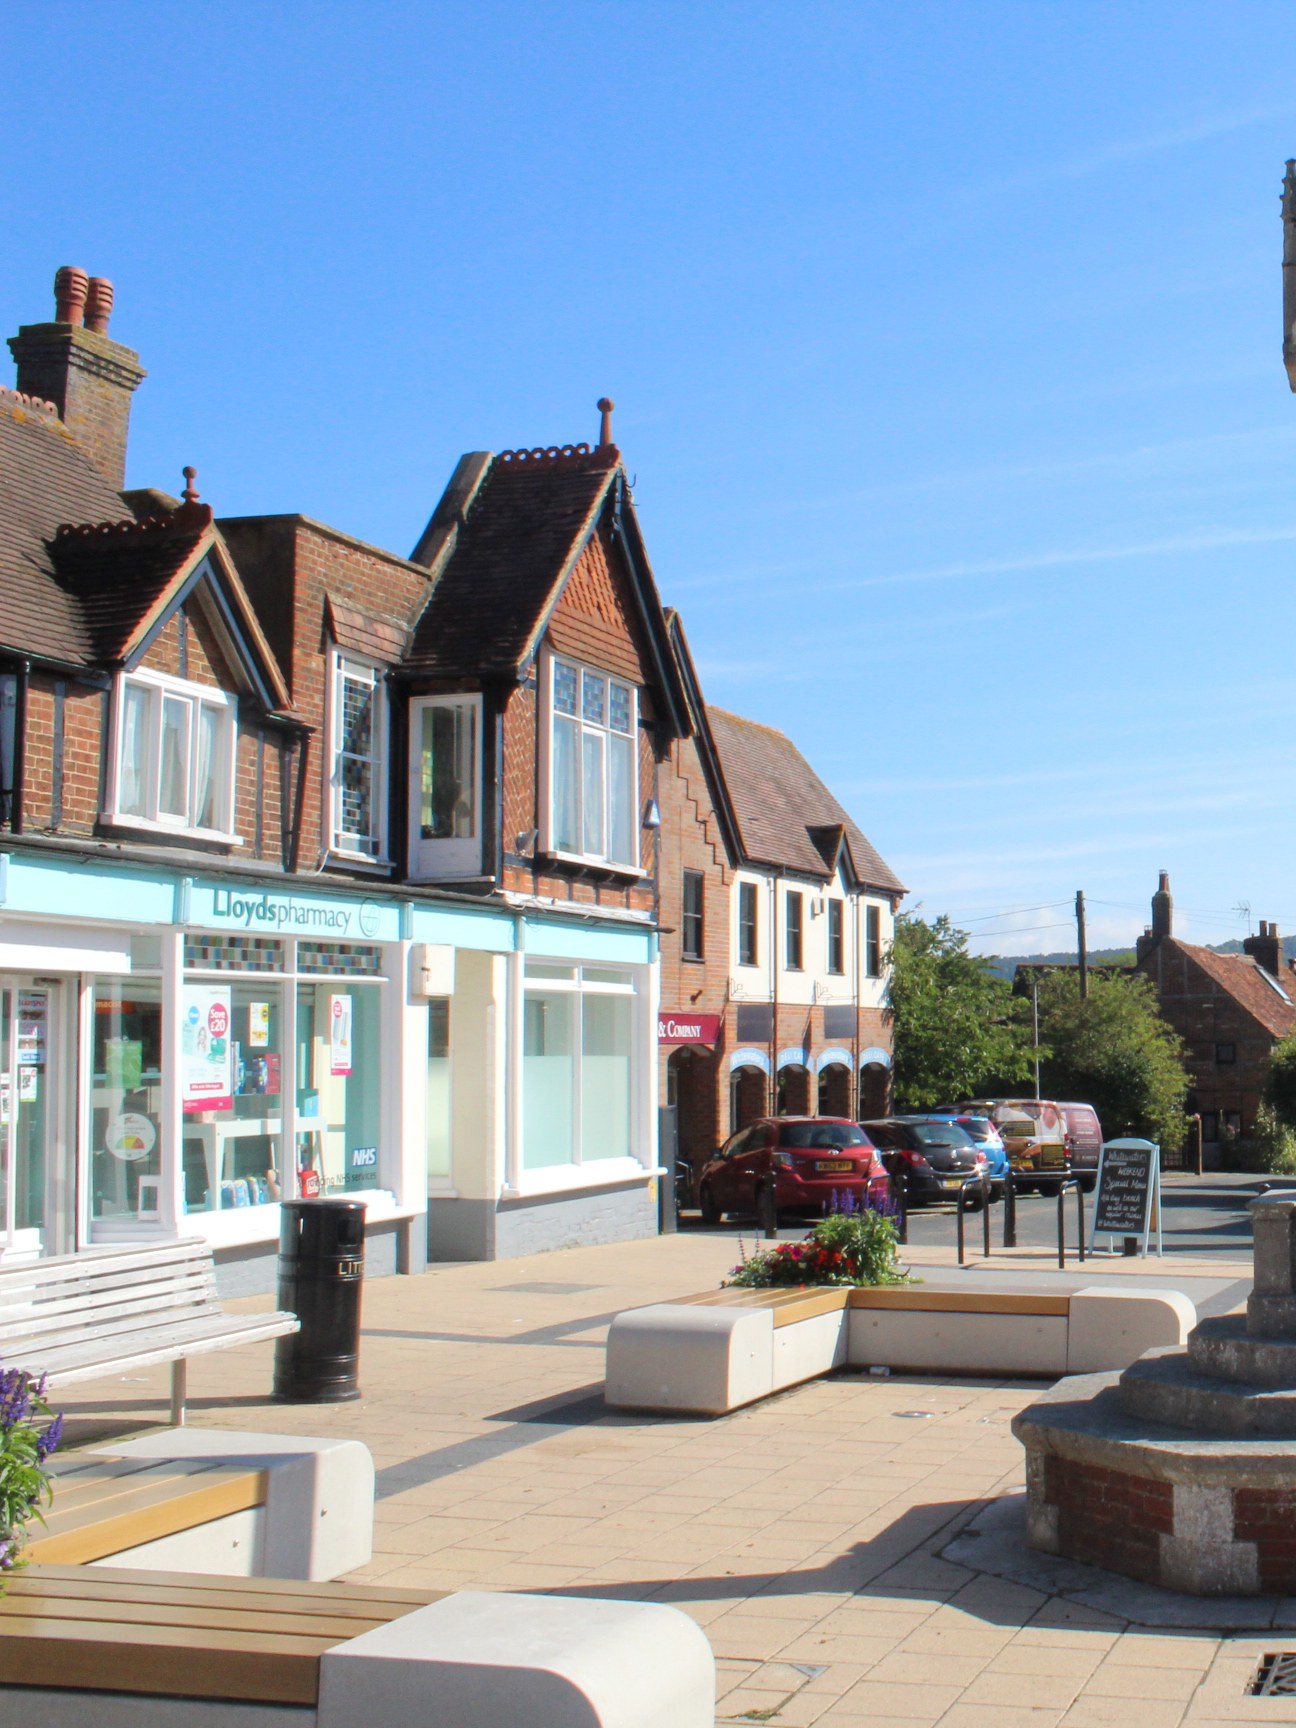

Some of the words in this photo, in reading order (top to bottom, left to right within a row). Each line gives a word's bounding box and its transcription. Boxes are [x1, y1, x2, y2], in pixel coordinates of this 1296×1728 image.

[213, 888, 352, 935] Lloydspharmacy
[210, 1009, 226, 1019] Save
[210, 1019, 226, 1032] £20
[658, 1021, 667, 1037] &
[667, 1020, 702, 1038] COMPANY
[353, 1148, 376, 1165] NHS
[351, 1171, 377, 1182] services
[1118, 1167, 1145, 1177] WEEKEND
[1104, 1176, 1129, 1191] Special
[1131, 1180, 1147, 1189] Menu
